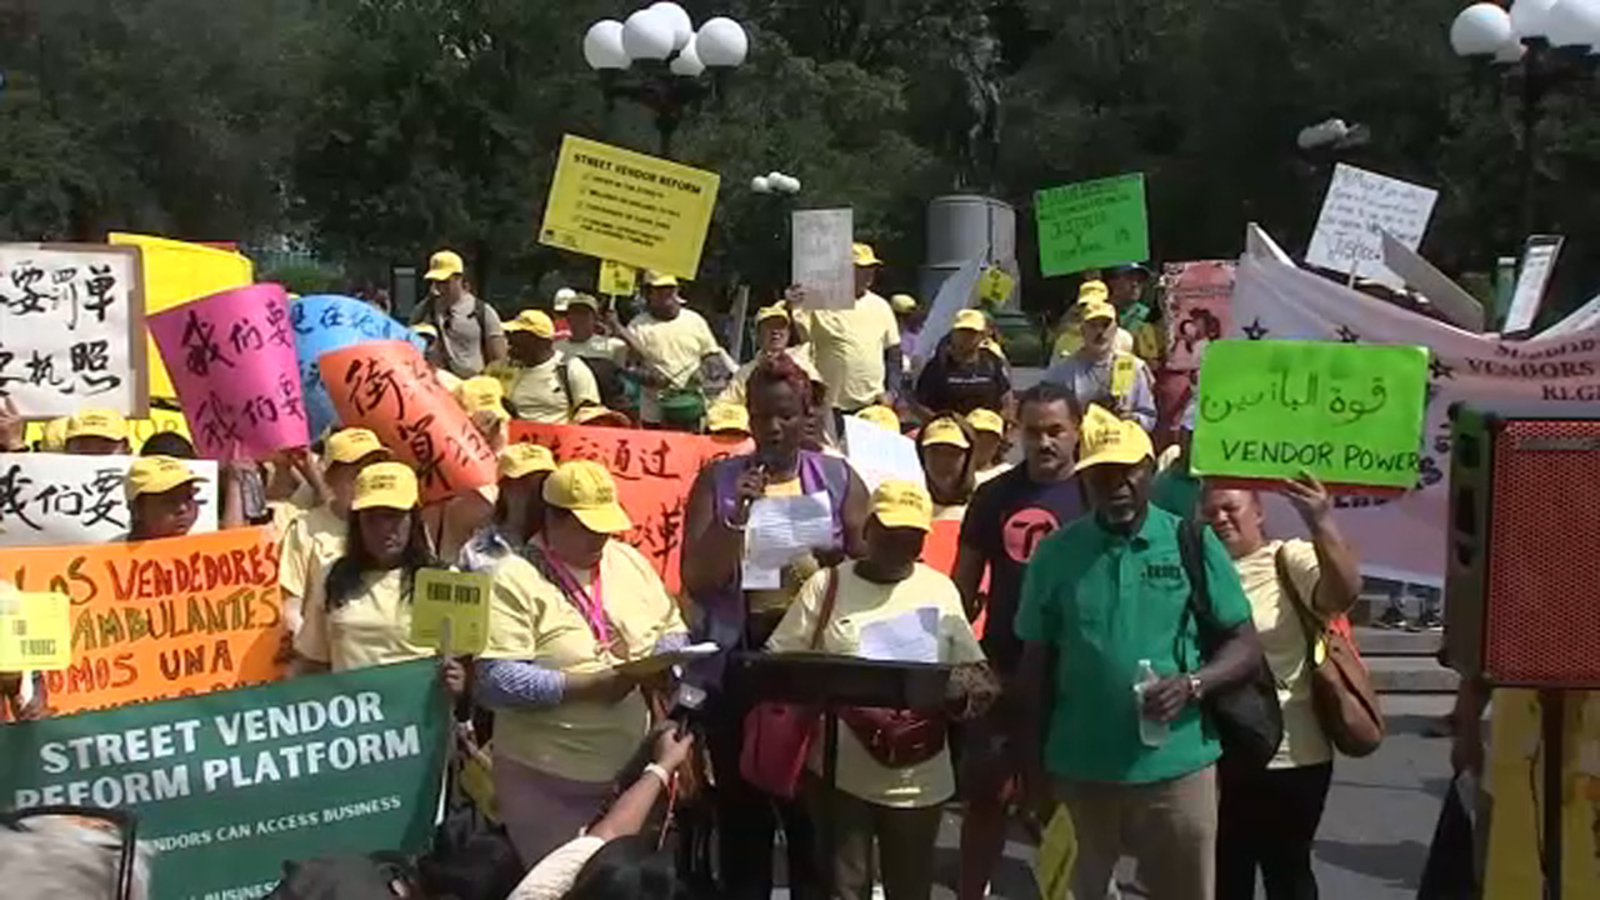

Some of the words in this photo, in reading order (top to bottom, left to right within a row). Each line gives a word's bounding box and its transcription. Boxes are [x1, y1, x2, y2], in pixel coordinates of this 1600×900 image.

[573, 153, 612, 171] STREET
[615, 164, 657, 182] VENDOR
[0, 259, 116, 330] 要罚单
[1220, 439, 1333, 467] VENDOR
[1344, 444, 1421, 472] POWER
[104, 541, 280, 601] VENDEDORES
[70, 587, 281, 653] AMBULANTES
[44, 652, 138, 695] OMOS
[159, 638, 234, 682] UNA
[40, 719, 201, 775] STREET
[215, 690, 385, 747] VENDOR
[203, 724, 421, 792] PLATFORM
[150, 829, 212, 853] NDORS
[216, 823, 252, 843] CAN
[255, 811, 320, 836] ACCESS
[323, 795, 402, 823] BUSINESS
